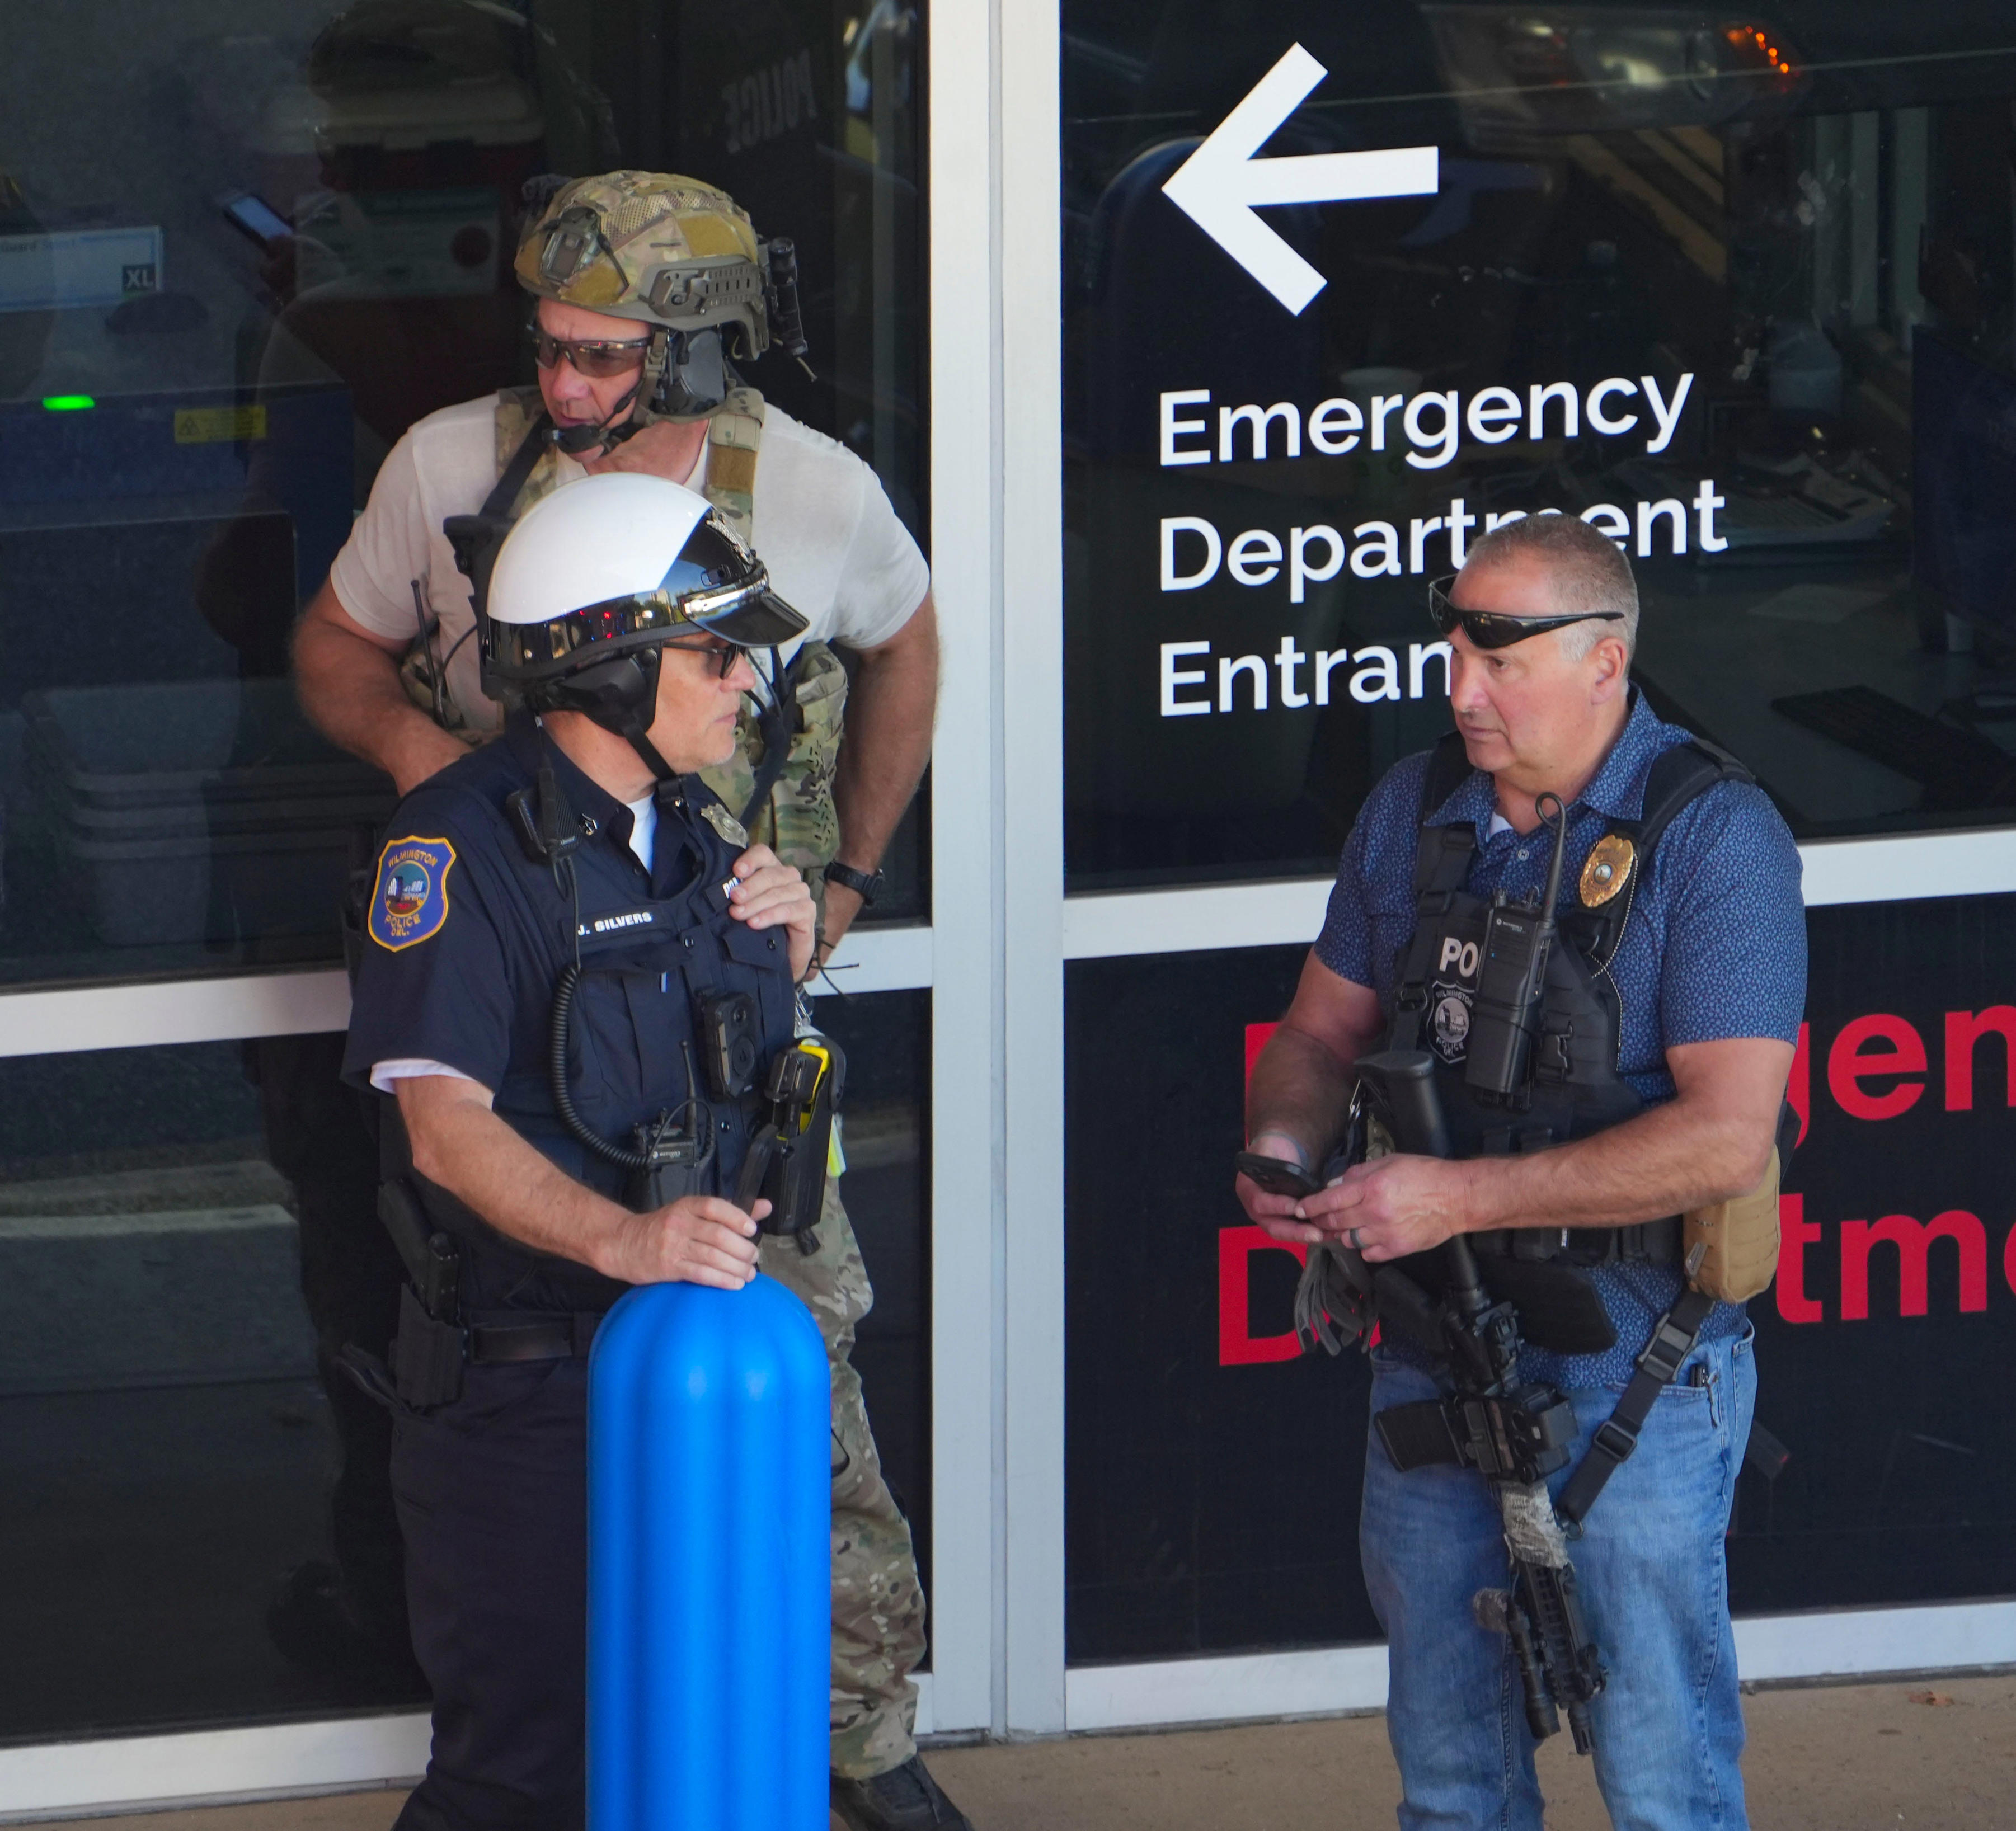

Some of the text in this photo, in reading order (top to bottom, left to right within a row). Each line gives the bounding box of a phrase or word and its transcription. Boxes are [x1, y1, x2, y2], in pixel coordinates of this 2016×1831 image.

[125, 269, 154, 289] XL
[1160, 373, 1694, 469] Emergency
[1160, 479, 1728, 604] Departent
[1160, 636, 1453, 717] Entran
[388, 850, 438, 867] WILMINGTON
[385, 913, 421, 927] POLICE
[577, 911, 653, 936] J. SILVERS
[1435, 989, 1474, 1008] WILMINGTON
